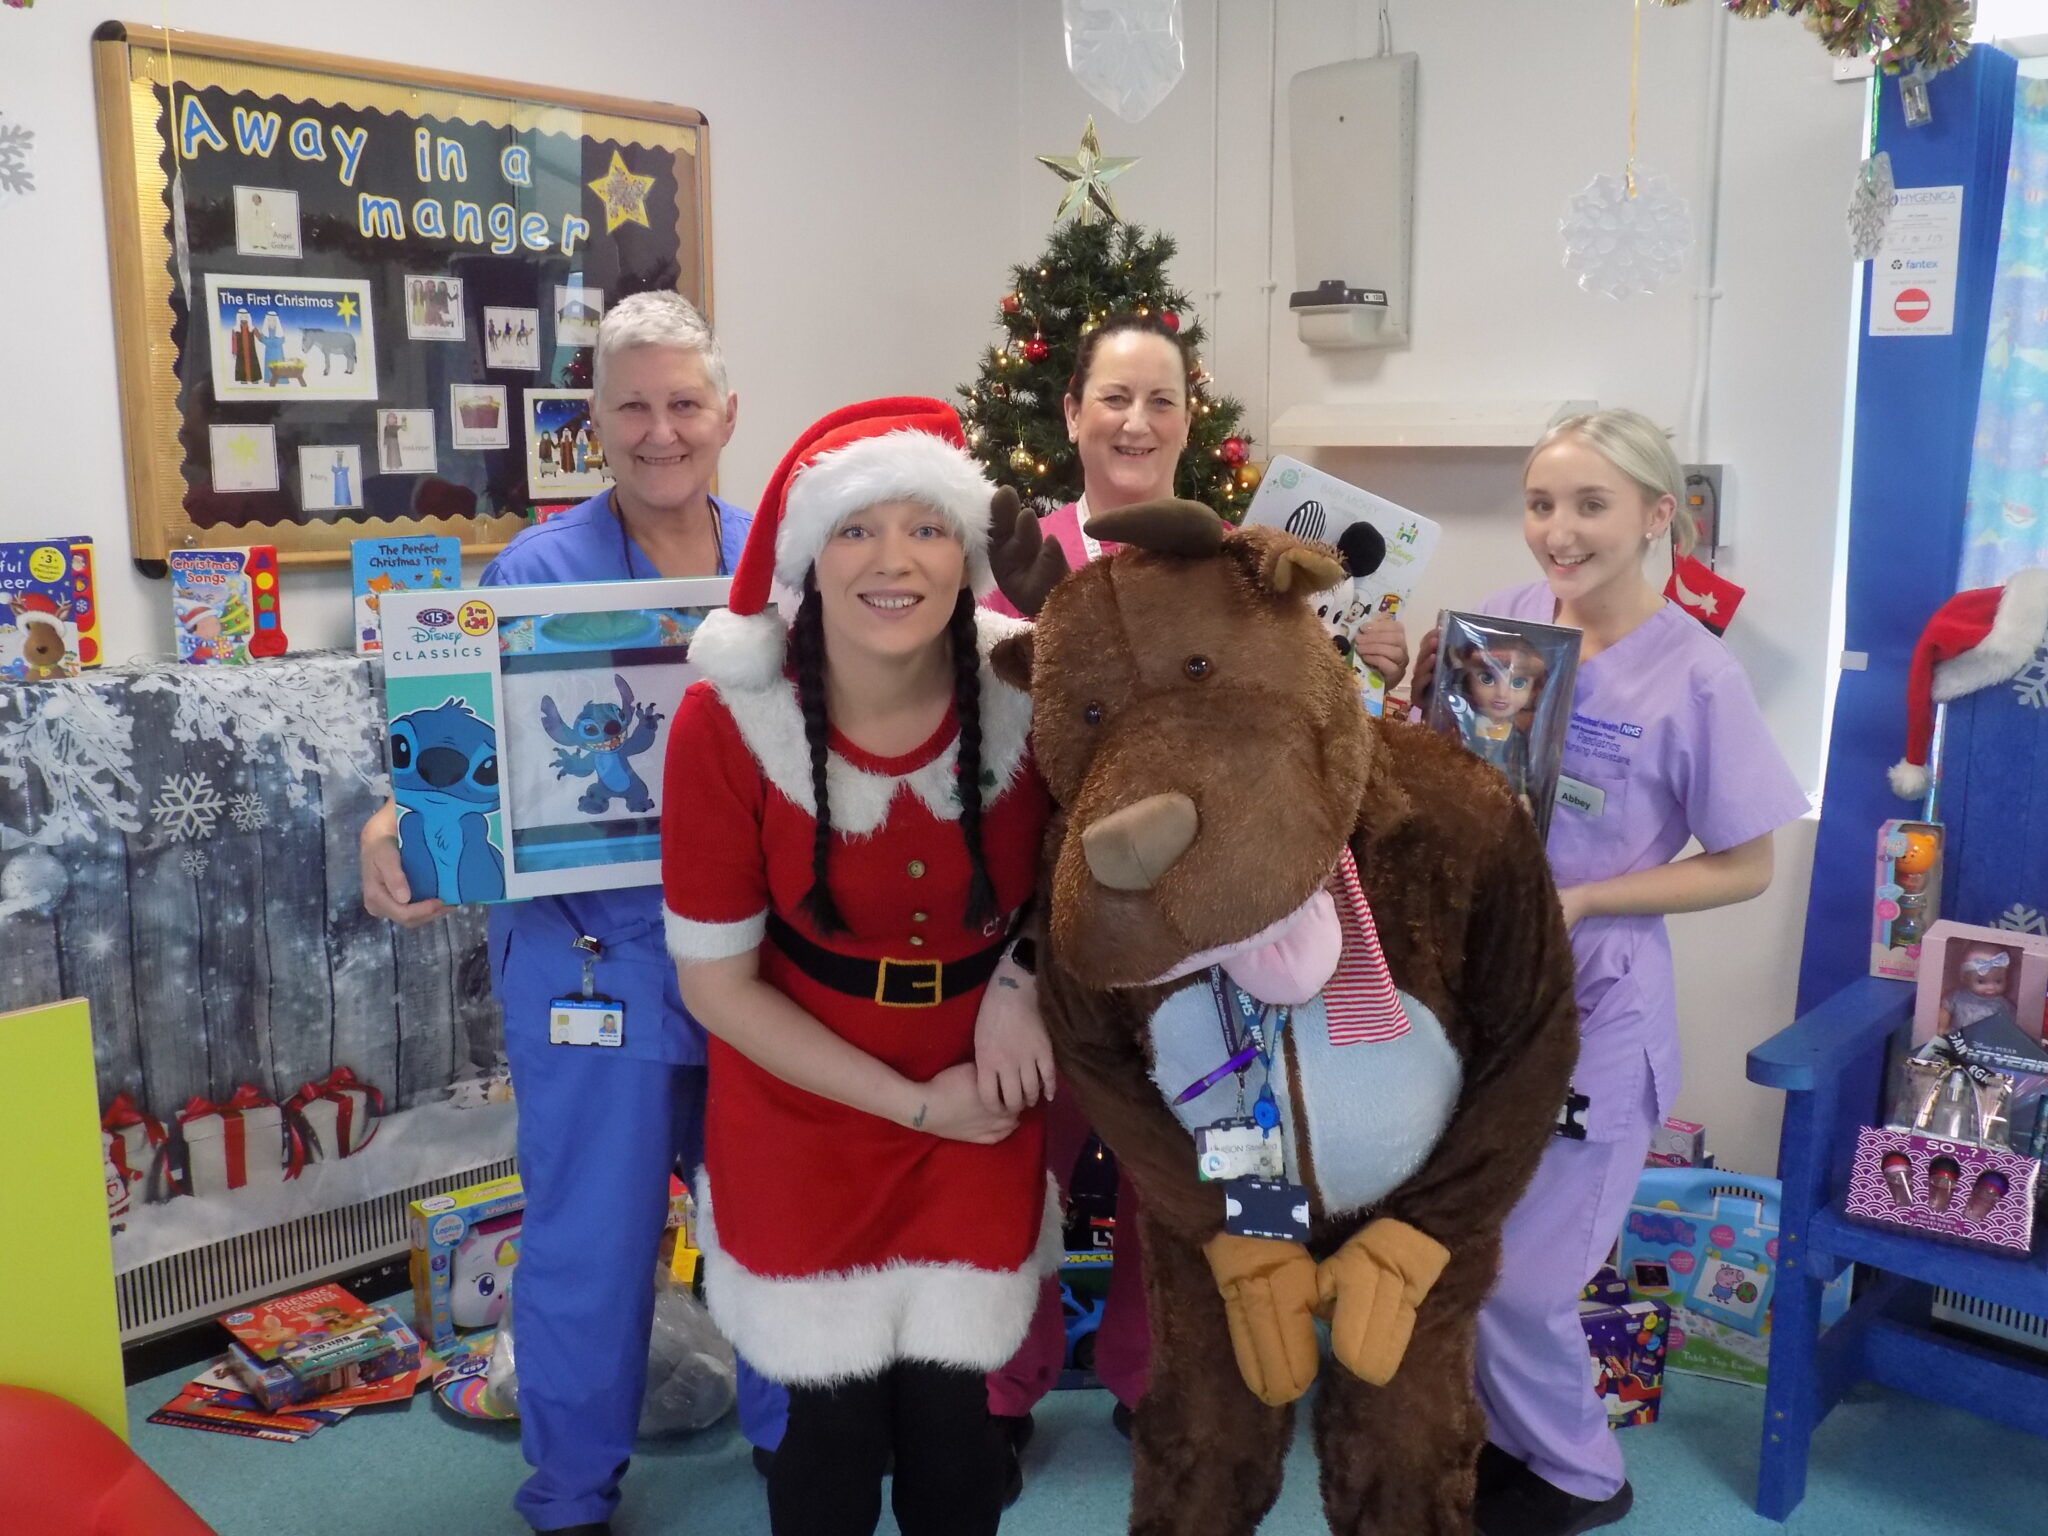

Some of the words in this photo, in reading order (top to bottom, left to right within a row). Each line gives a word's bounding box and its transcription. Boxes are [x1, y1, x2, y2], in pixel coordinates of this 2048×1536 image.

[180, 95, 368, 187] Away
[415, 127, 467, 182] in
[501, 145, 533, 187] a
[1900, 191, 1957, 202] HYGENICA
[358, 193, 590, 256] manger
[273, 232, 292, 241] Angel
[1906, 260, 1938, 269] fantex
[220, 292, 243, 305] The
[247, 294, 271, 306] First
[274, 294, 334, 308] Christmas
[378, 545, 398, 555] The
[402, 542, 439, 554] Perfect
[45, 554, 53, 563] 3
[172, 557, 238, 571] Christmas
[369, 557, 421, 568] Christmas
[424, 555, 447, 566] Tree
[0, 560, 21, 573] ful
[0, 579, 33, 589] eer
[187, 572, 226, 586] Songs
[466, 606, 474, 617] 2
[408, 627, 462, 645] Disney
[393, 647, 482, 661] CLASSICS
[1621, 725, 1641, 736] NHS
[1577, 732, 1622, 753] Paediatrics
[1592, 748, 1631, 766] Assistant
[1562, 792, 1591, 811] Abbey
[1236, 990, 1255, 1017] NHS
[1250, 1025, 1264, 1043] NH
[1995, 1045, 2018, 1055] PIXAR
[436, 1224, 461, 1235] Laptop
[263, 1289, 328, 1313] FRIENDS
[282, 1291, 340, 1315] FOREVER
[1682, 1350, 1707, 1363] Table
